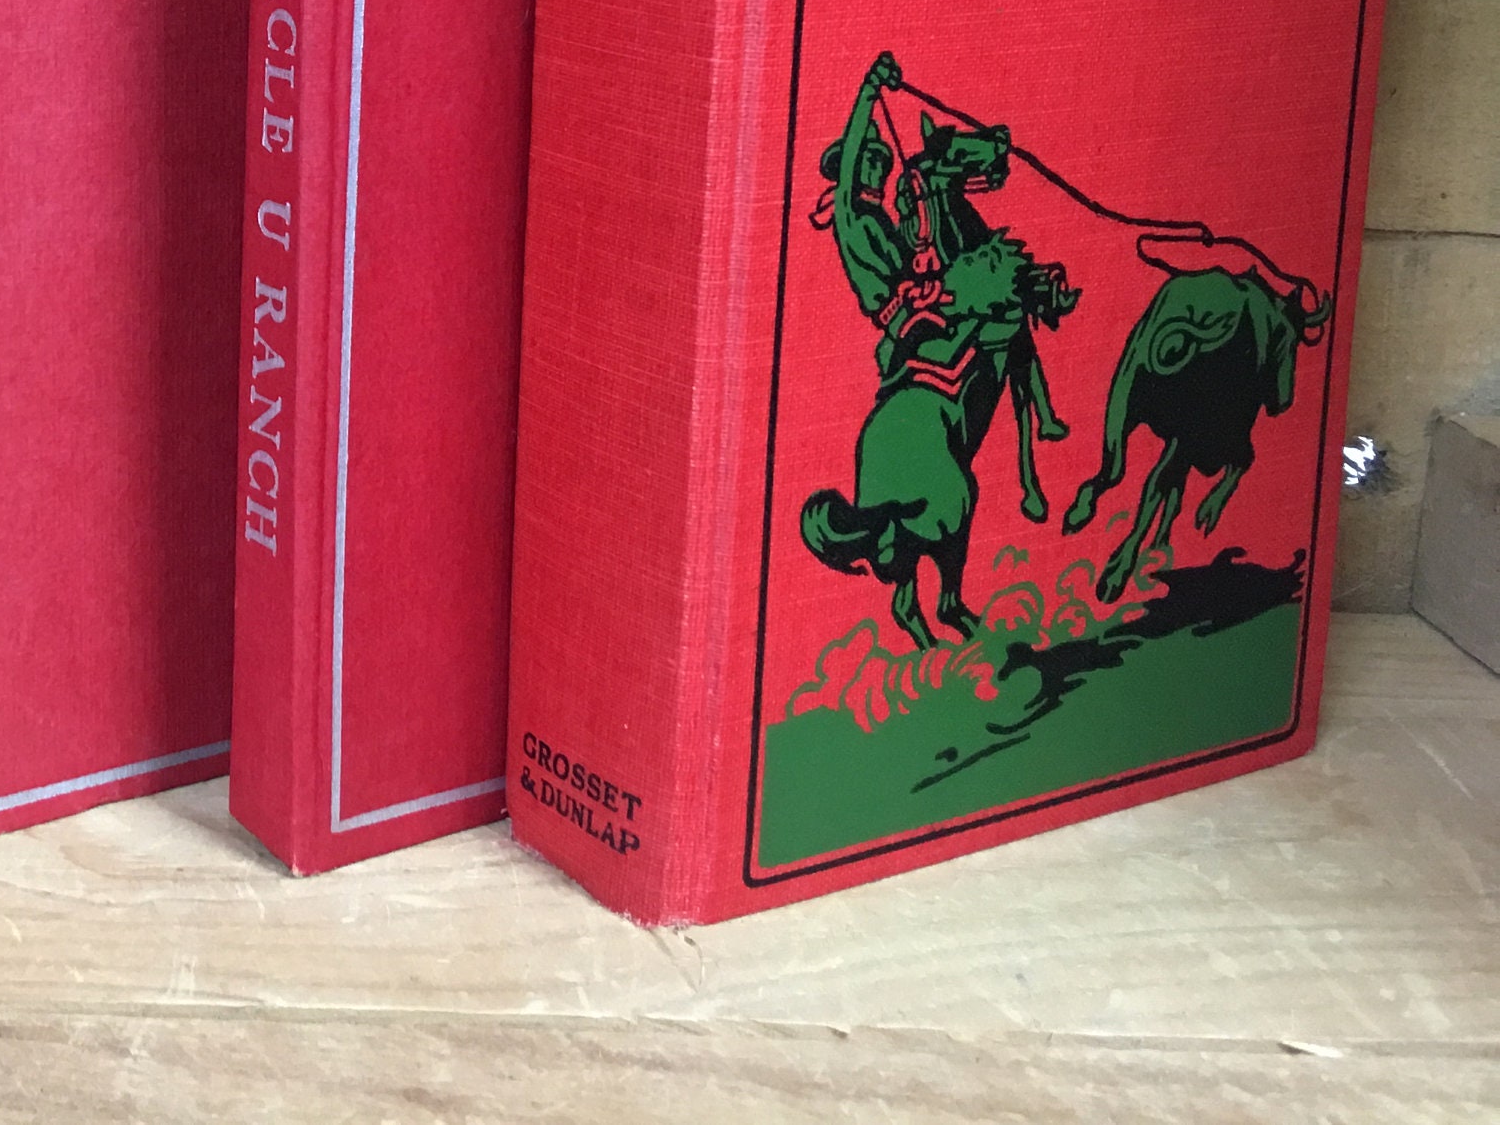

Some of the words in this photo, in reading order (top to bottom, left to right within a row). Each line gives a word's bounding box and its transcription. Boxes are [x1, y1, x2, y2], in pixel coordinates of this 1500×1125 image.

[256, 199, 293, 251] U
[244, 276, 290, 556] RANCH
[520, 765, 539, 801] &
[540, 778, 641, 856] DUNLAP
[523, 731, 643, 821] GROSSET
